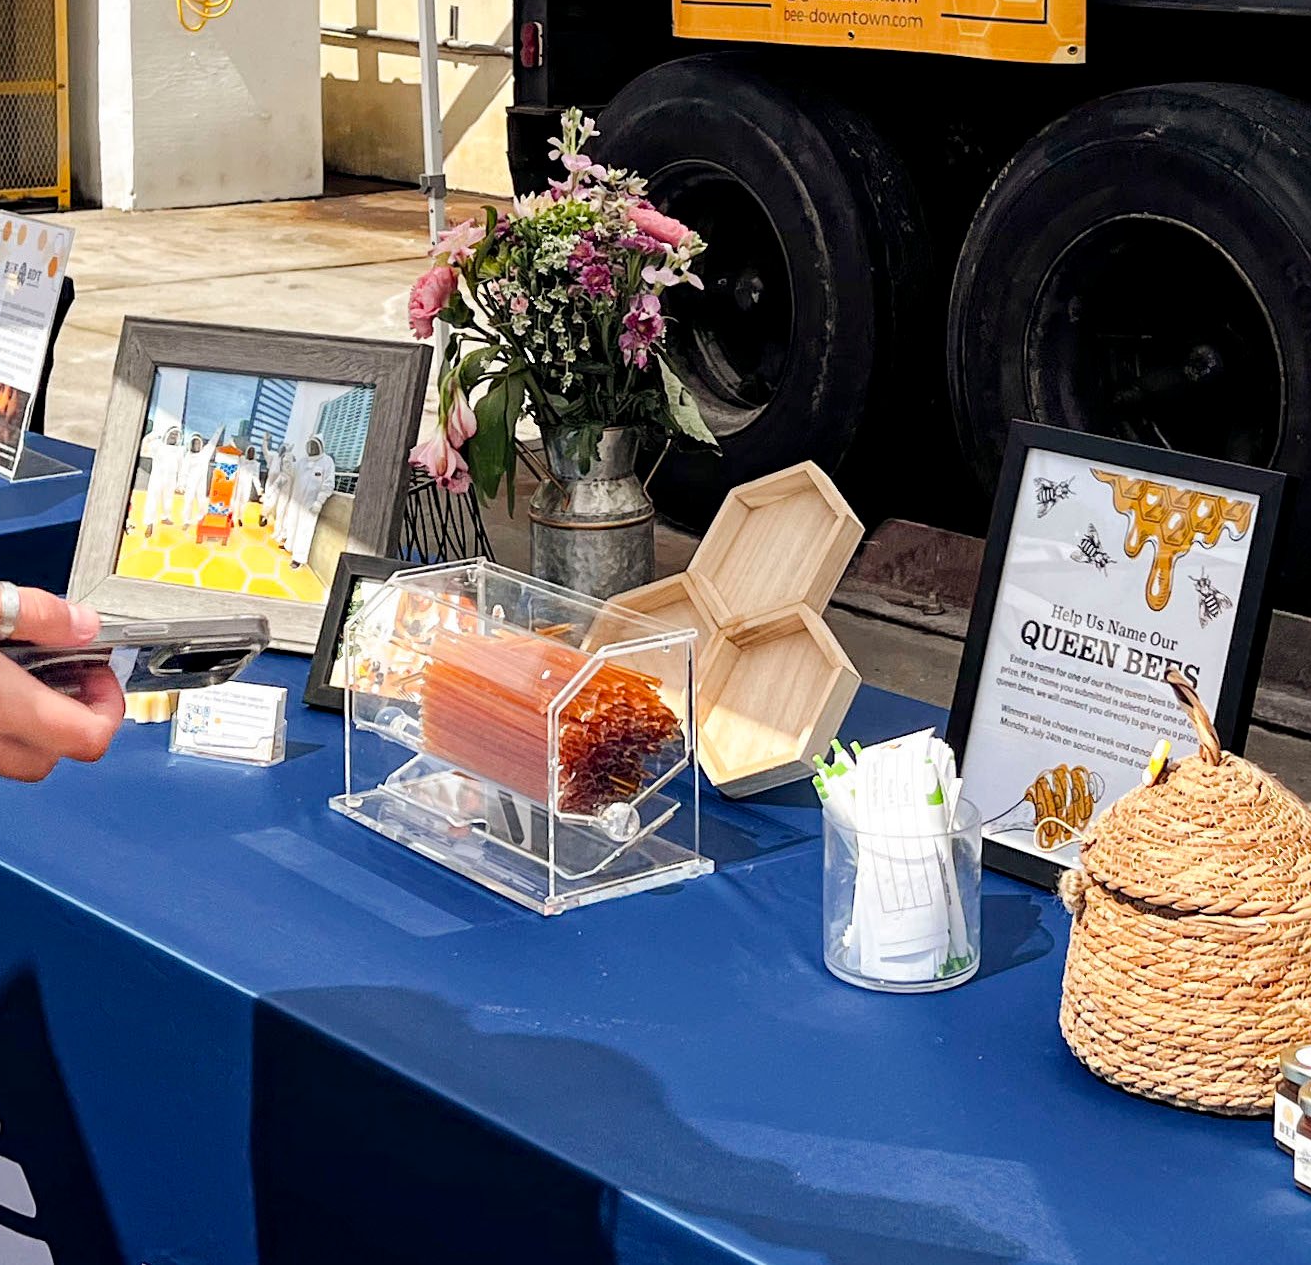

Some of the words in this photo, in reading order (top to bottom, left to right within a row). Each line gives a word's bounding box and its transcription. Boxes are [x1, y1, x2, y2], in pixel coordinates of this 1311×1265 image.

[784, 7, 923, 29] bee-downtown.com
[1051, 604, 1082, 628] Help
[1086, 613, 1105, 631] Us
[1107, 619, 1147, 642] Name
[1150, 631, 1178, 651] Our
[1021, 620, 1120, 668] QUEEN
[1059, 683, 1073, 693] you
[1162, 714, 1177, 723] one
[1123, 689, 1146, 700] queen
[1088, 706, 1102, 715] you
[1139, 721, 1156, 731] give
[1156, 726, 1171, 736] you
[1118, 756, 1134, 766] and
